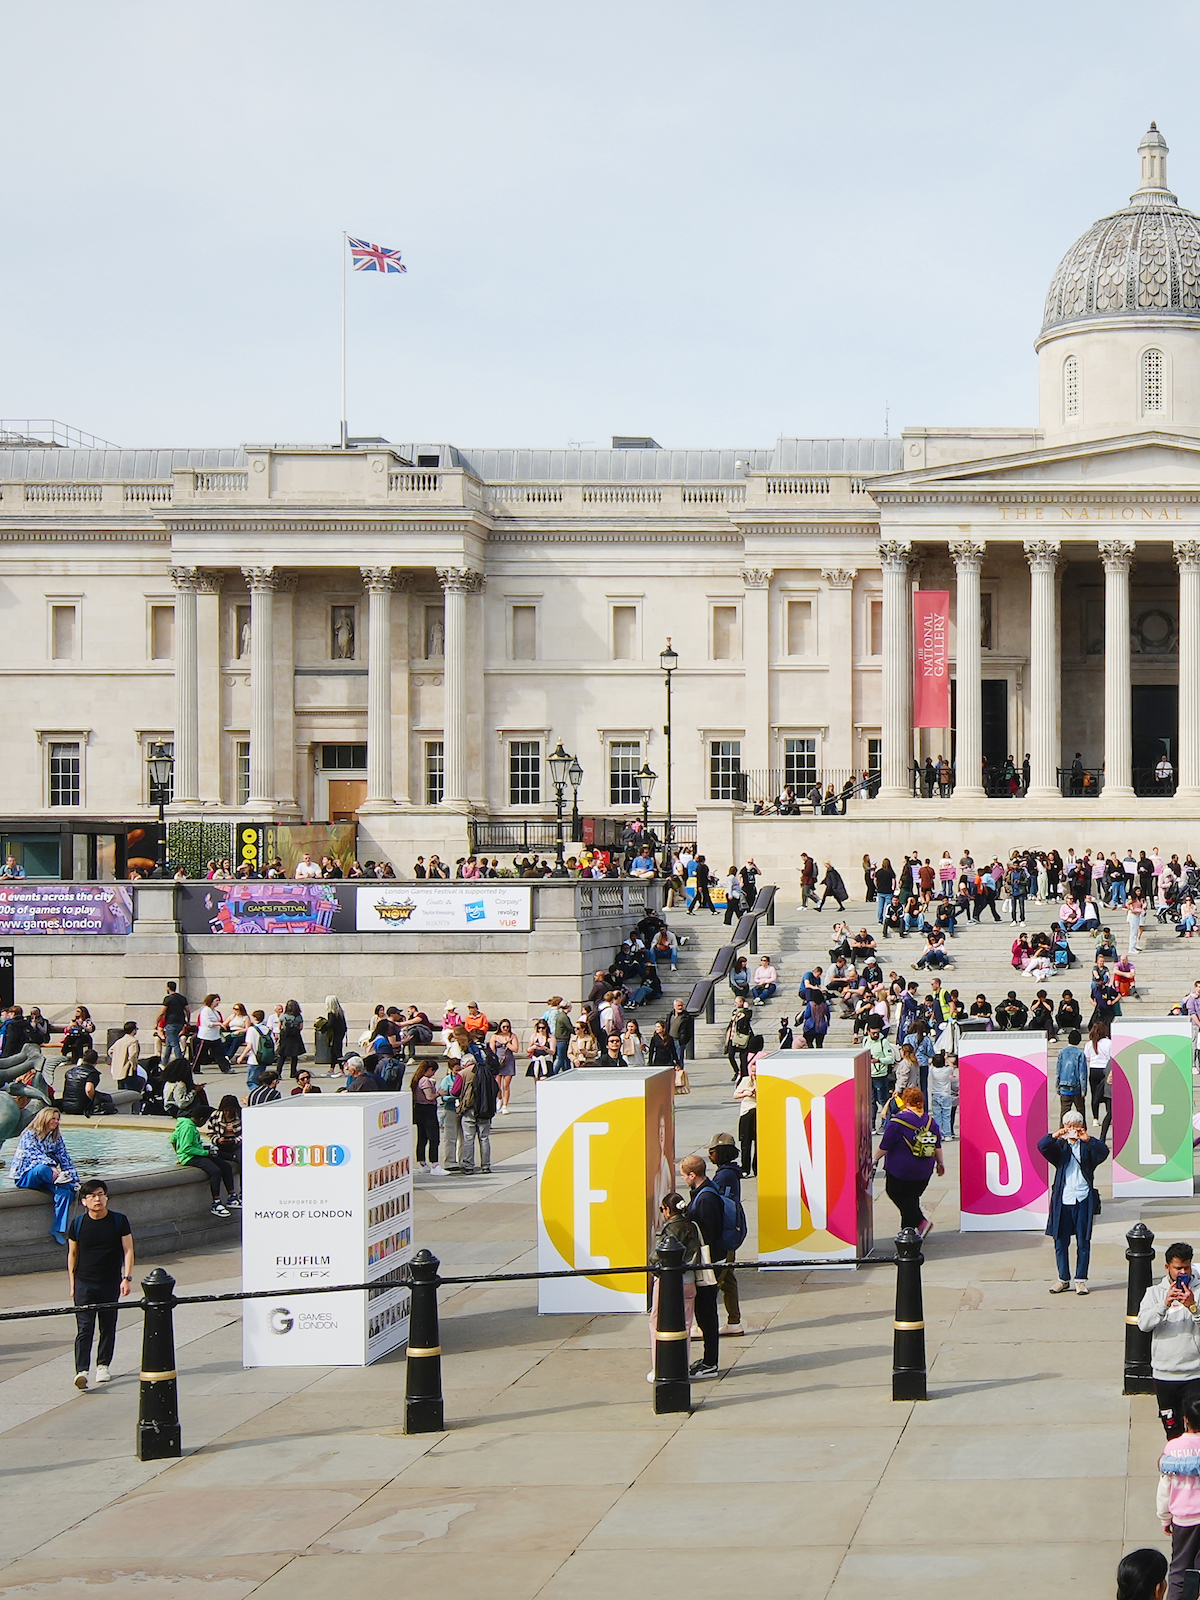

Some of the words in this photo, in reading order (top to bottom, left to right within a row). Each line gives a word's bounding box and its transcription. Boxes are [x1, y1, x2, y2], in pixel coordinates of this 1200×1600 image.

[998, 507, 1045, 520] THE
[1060, 507, 1184, 520] NATIONAL
[924, 612, 934, 676] NATIONAL
[934, 613, 945, 676] GALLERY
[8, 893, 41, 901] events
[76, 892, 93, 901] the
[94, 892, 114, 902] city
[464, 888, 498, 896] supported
[498, 888, 507, 896] by
[17, 905, 29, 914] of
[30, 906, 60, 915] games
[62, 906, 73, 914] to
[75, 904, 96, 915] play
[234, 900, 312, 916] LONDON
[382, 910, 410, 919] NOW
[0, 918, 102, 930] ww.games.london
[268, 1147, 337, 1164] ENSEMBLE
[254, 1210, 290, 1219] MAYOR
[292, 1210, 306, 1218] OF
[308, 1210, 352, 1218] LONDON
[276, 1256, 330, 1266] FUJIFILM
[300, 1270, 330, 1278] GFX
[298, 1312, 332, 1321] GAMES
[298, 1322, 338, 1330] LONDON
